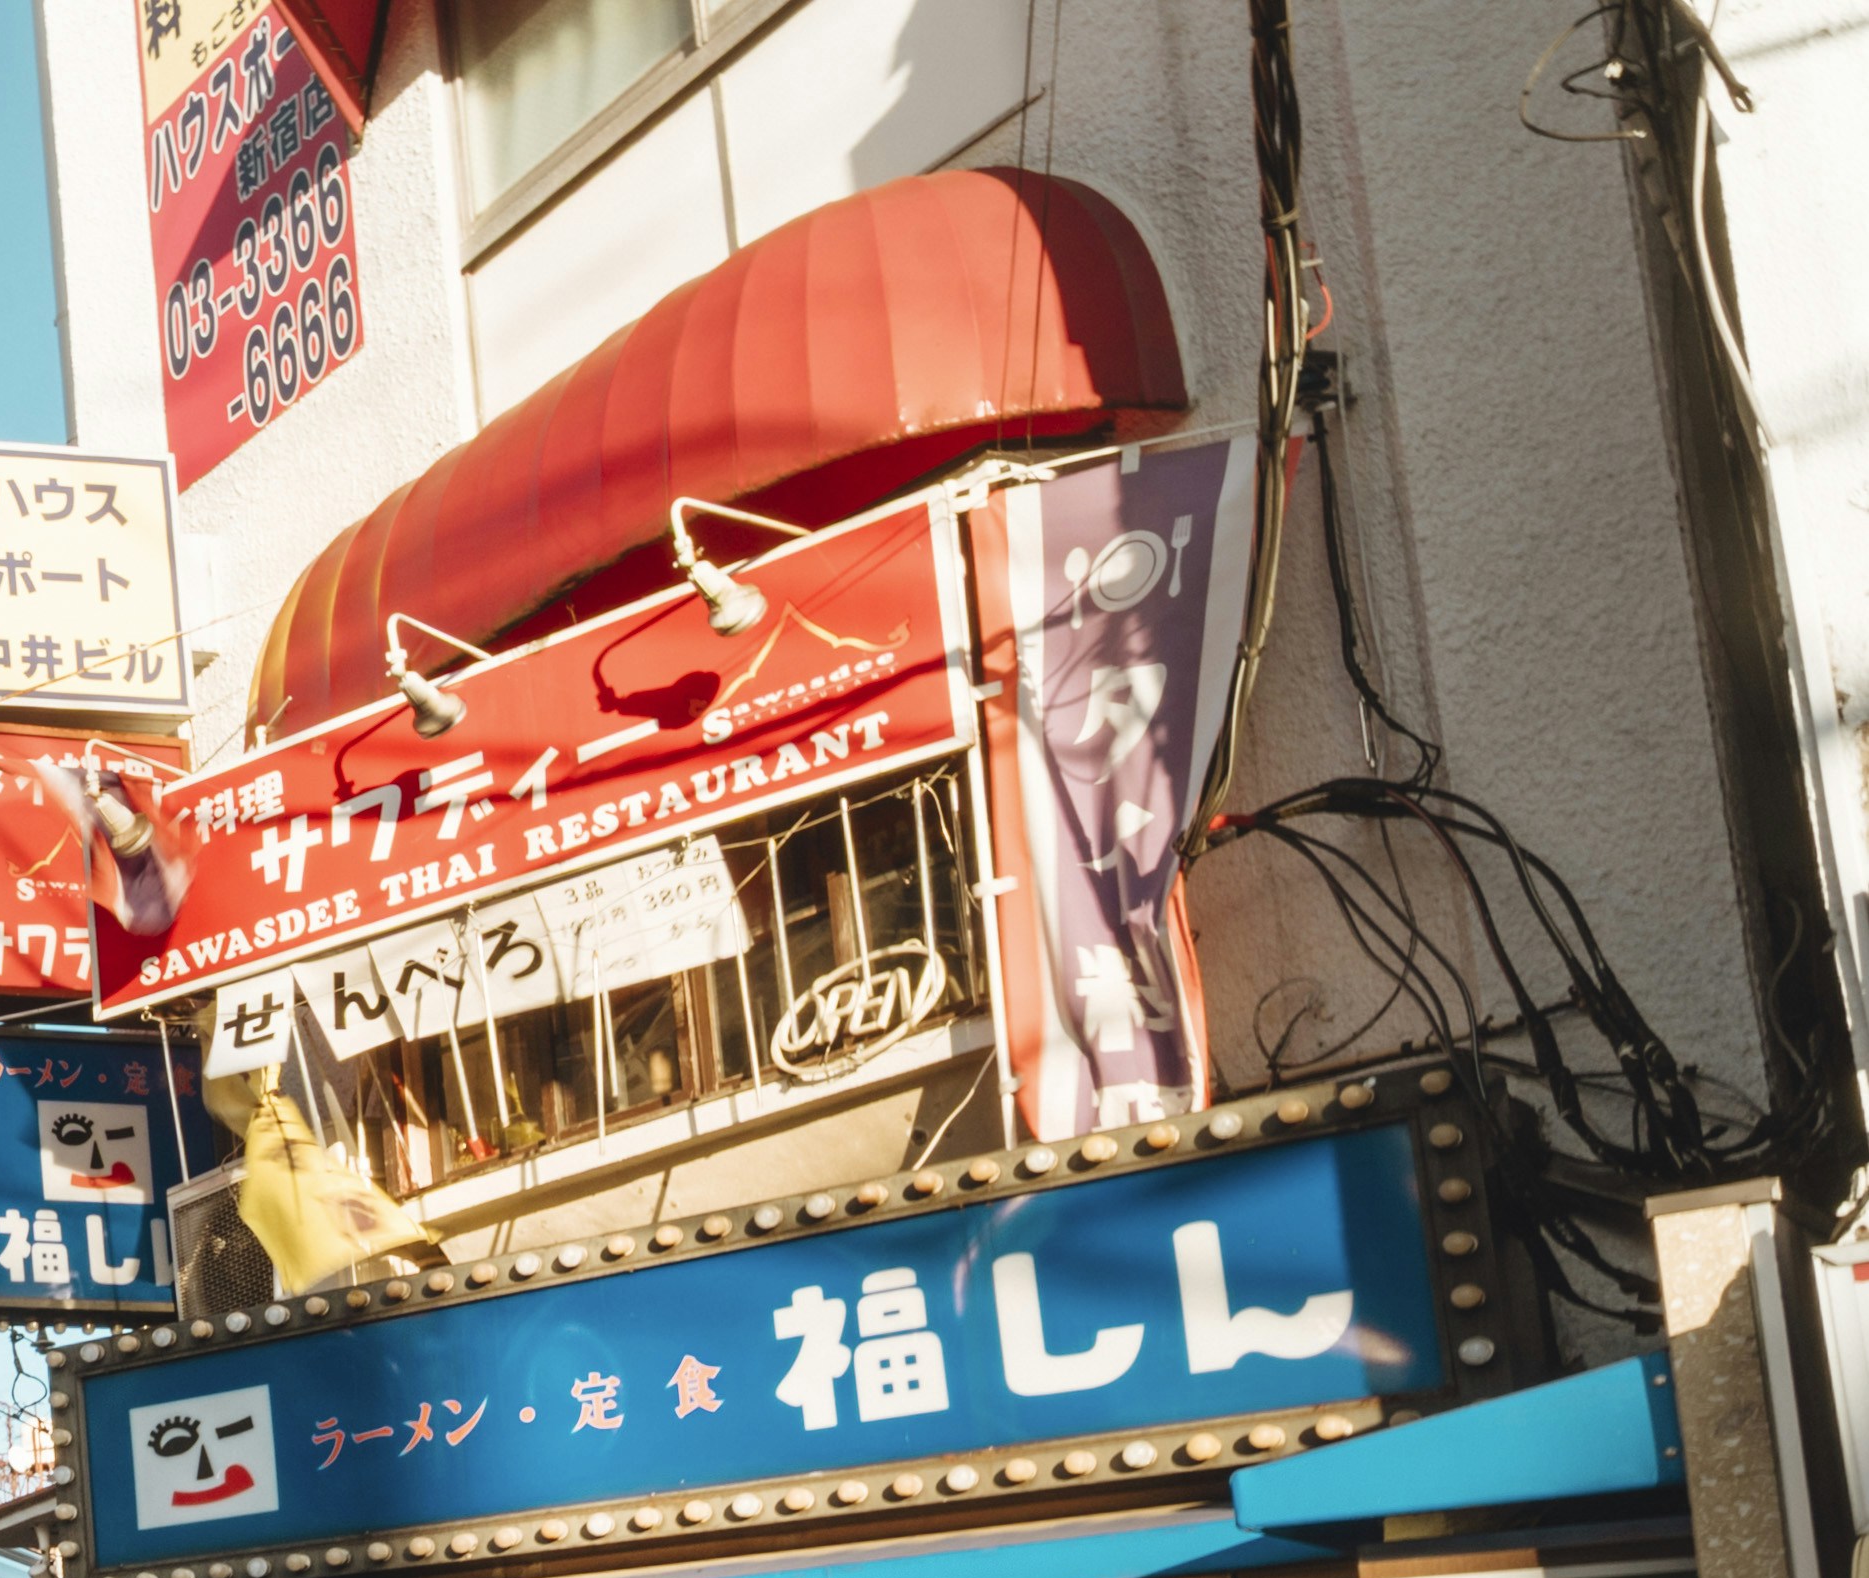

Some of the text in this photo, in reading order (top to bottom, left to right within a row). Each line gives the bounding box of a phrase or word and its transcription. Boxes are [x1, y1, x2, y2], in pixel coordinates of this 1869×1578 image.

[165, 142, 349, 379] 03-3366
[227, 256, 358, 428] -6666
[702, 652, 895, 745] Sawasdee
[139, 710, 892, 987] SAWASDEE THAI RESTAURANT
[250, 717, 661, 894] サワディー
[564, 879, 604, 905] 3品
[222, 903, 545, 1057] せんべろ
[779, 958, 939, 1052] OPEN
[773, 1219, 1355, 1433] 福しん
